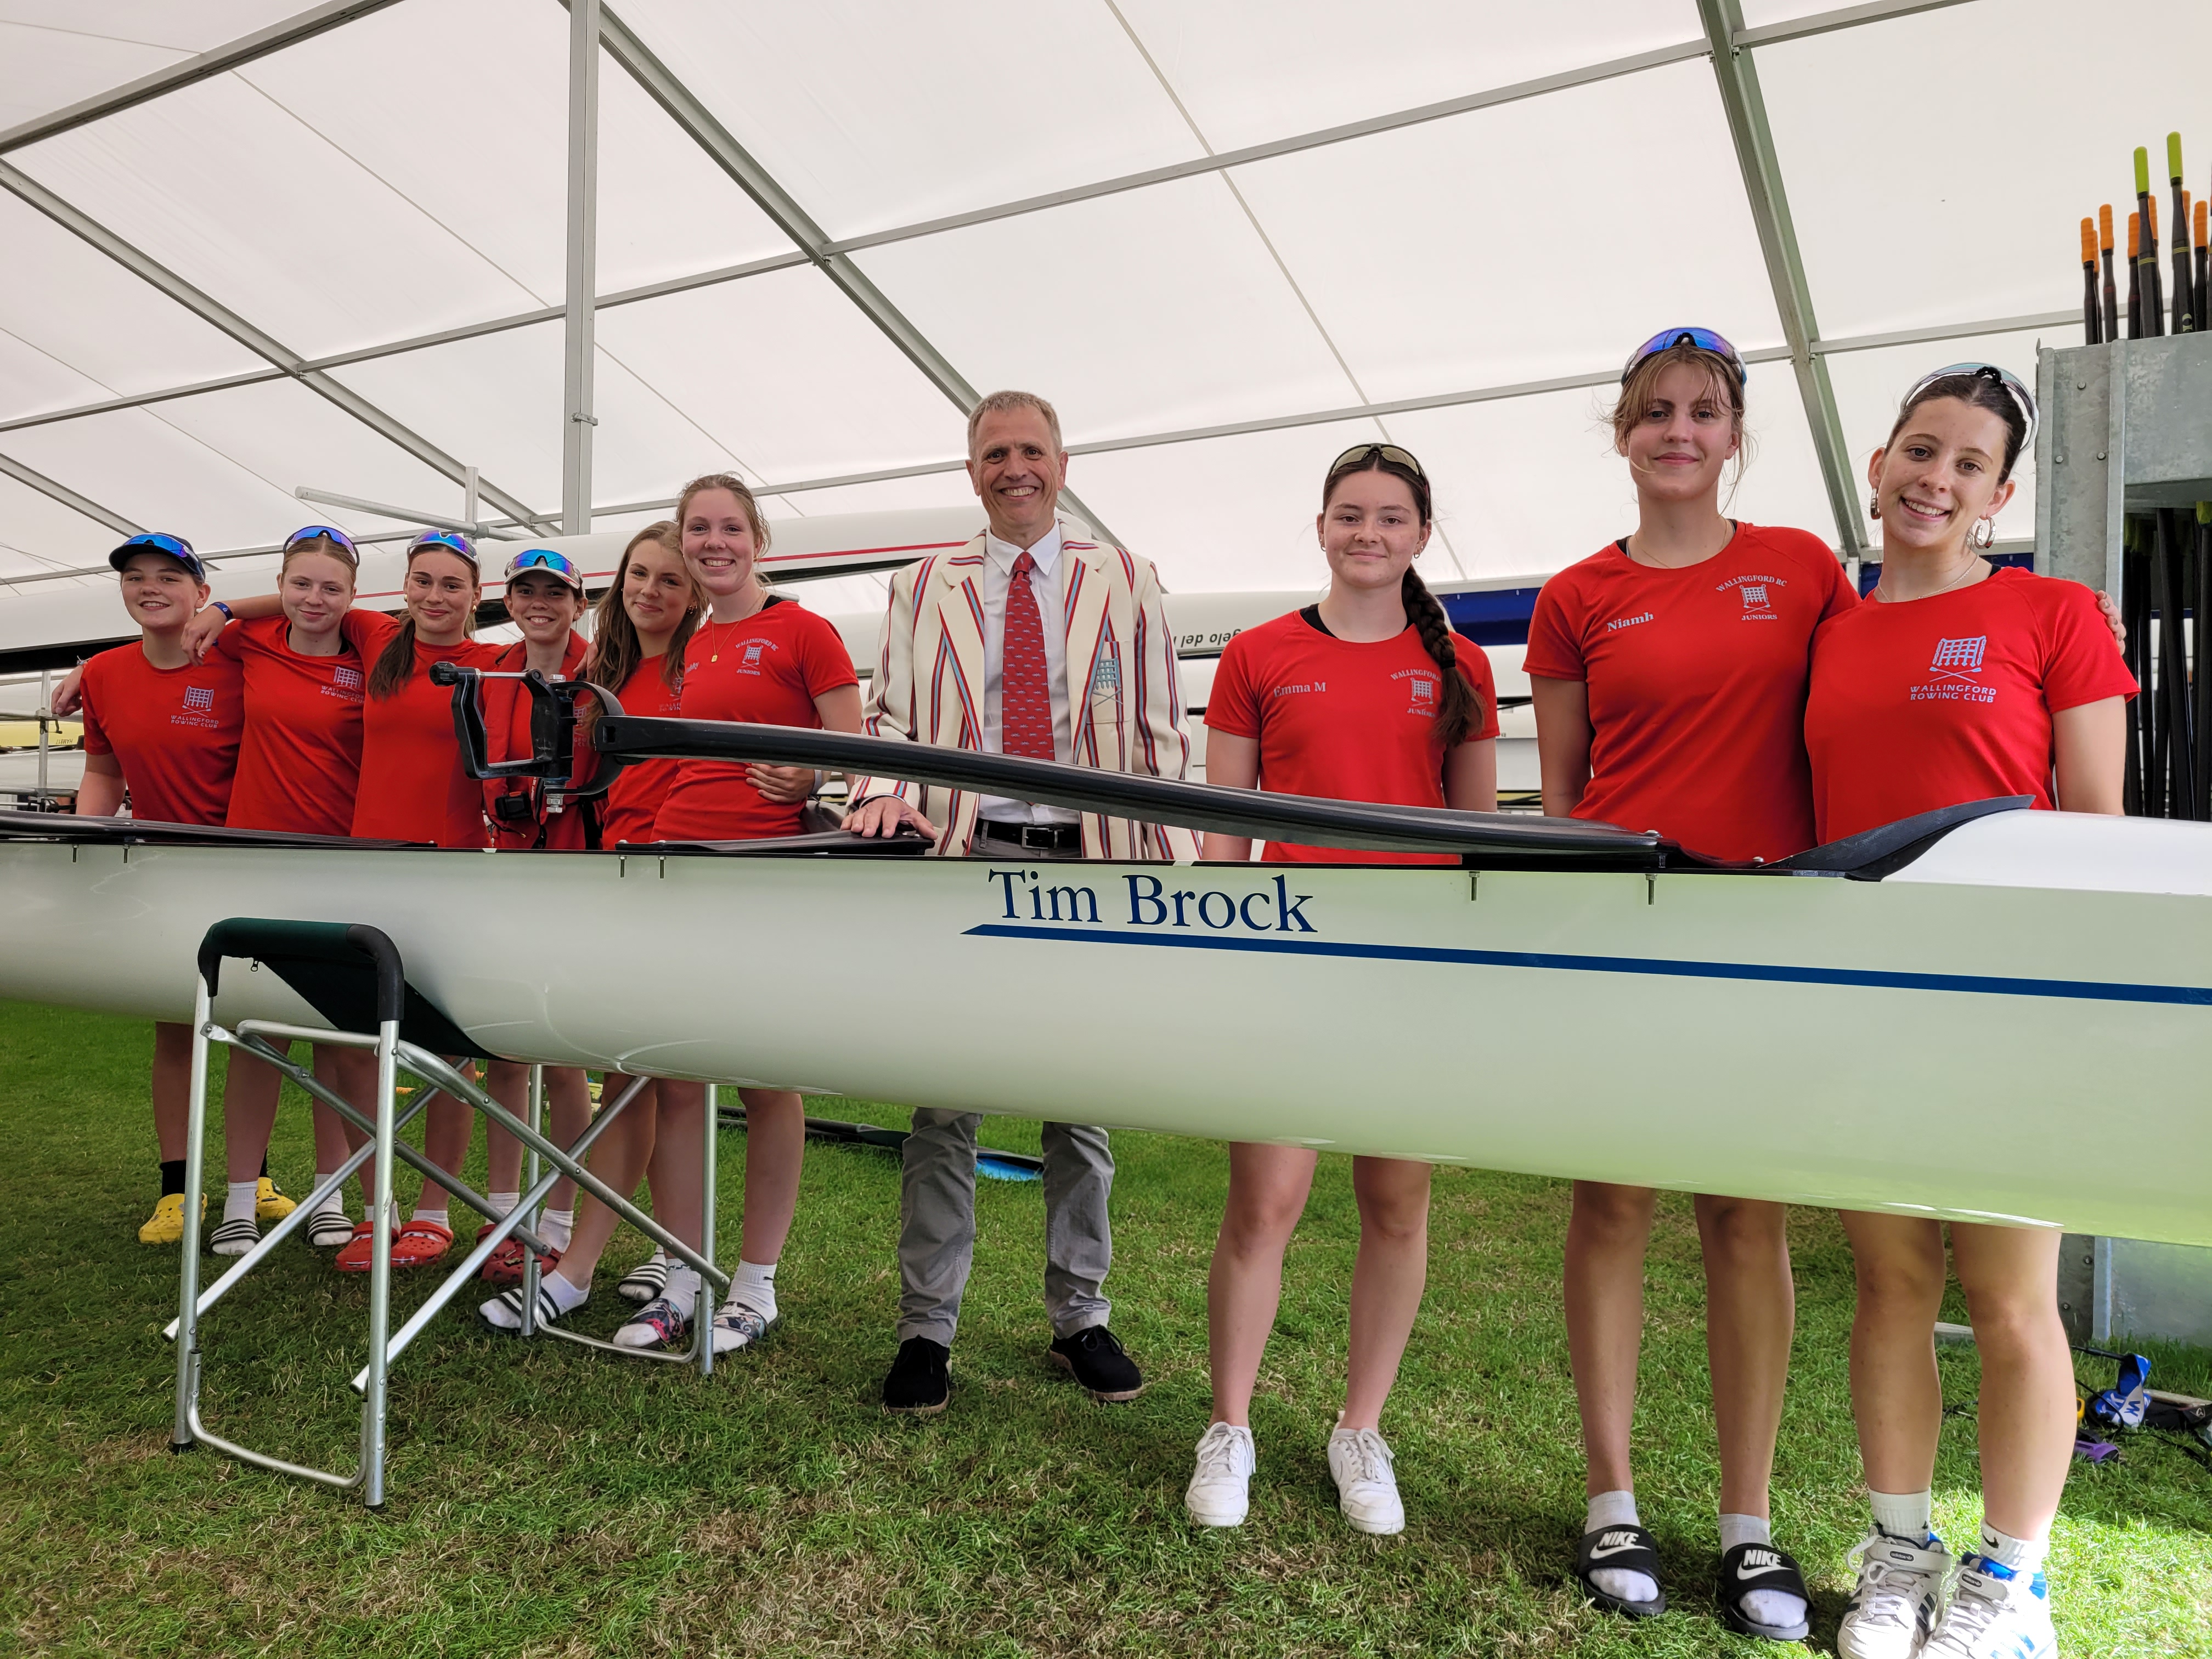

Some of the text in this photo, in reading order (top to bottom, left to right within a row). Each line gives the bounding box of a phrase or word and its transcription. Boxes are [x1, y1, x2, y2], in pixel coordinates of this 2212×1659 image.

[1716, 575, 1787, 591] WALLINGFORD RC
[1606, 612, 1654, 633] Niamh
[735, 638, 772, 649] WALLINGFORD
[1181, 634, 1203, 647] del
[320, 690, 348, 700] ROWING
[1273, 681, 1326, 698] Emma M
[1910, 684, 1996, 695] WALLINGFORD
[1910, 692, 1994, 703] ROWING CLUB
[171, 715, 219, 724] WALLINGFORD
[988, 868, 1318, 933] Tim Brock
[1598, 1531, 1639, 1547] NIKE
[1743, 1550, 1781, 1566] NIKE
[1962, 1575, 1975, 1584] adidas
